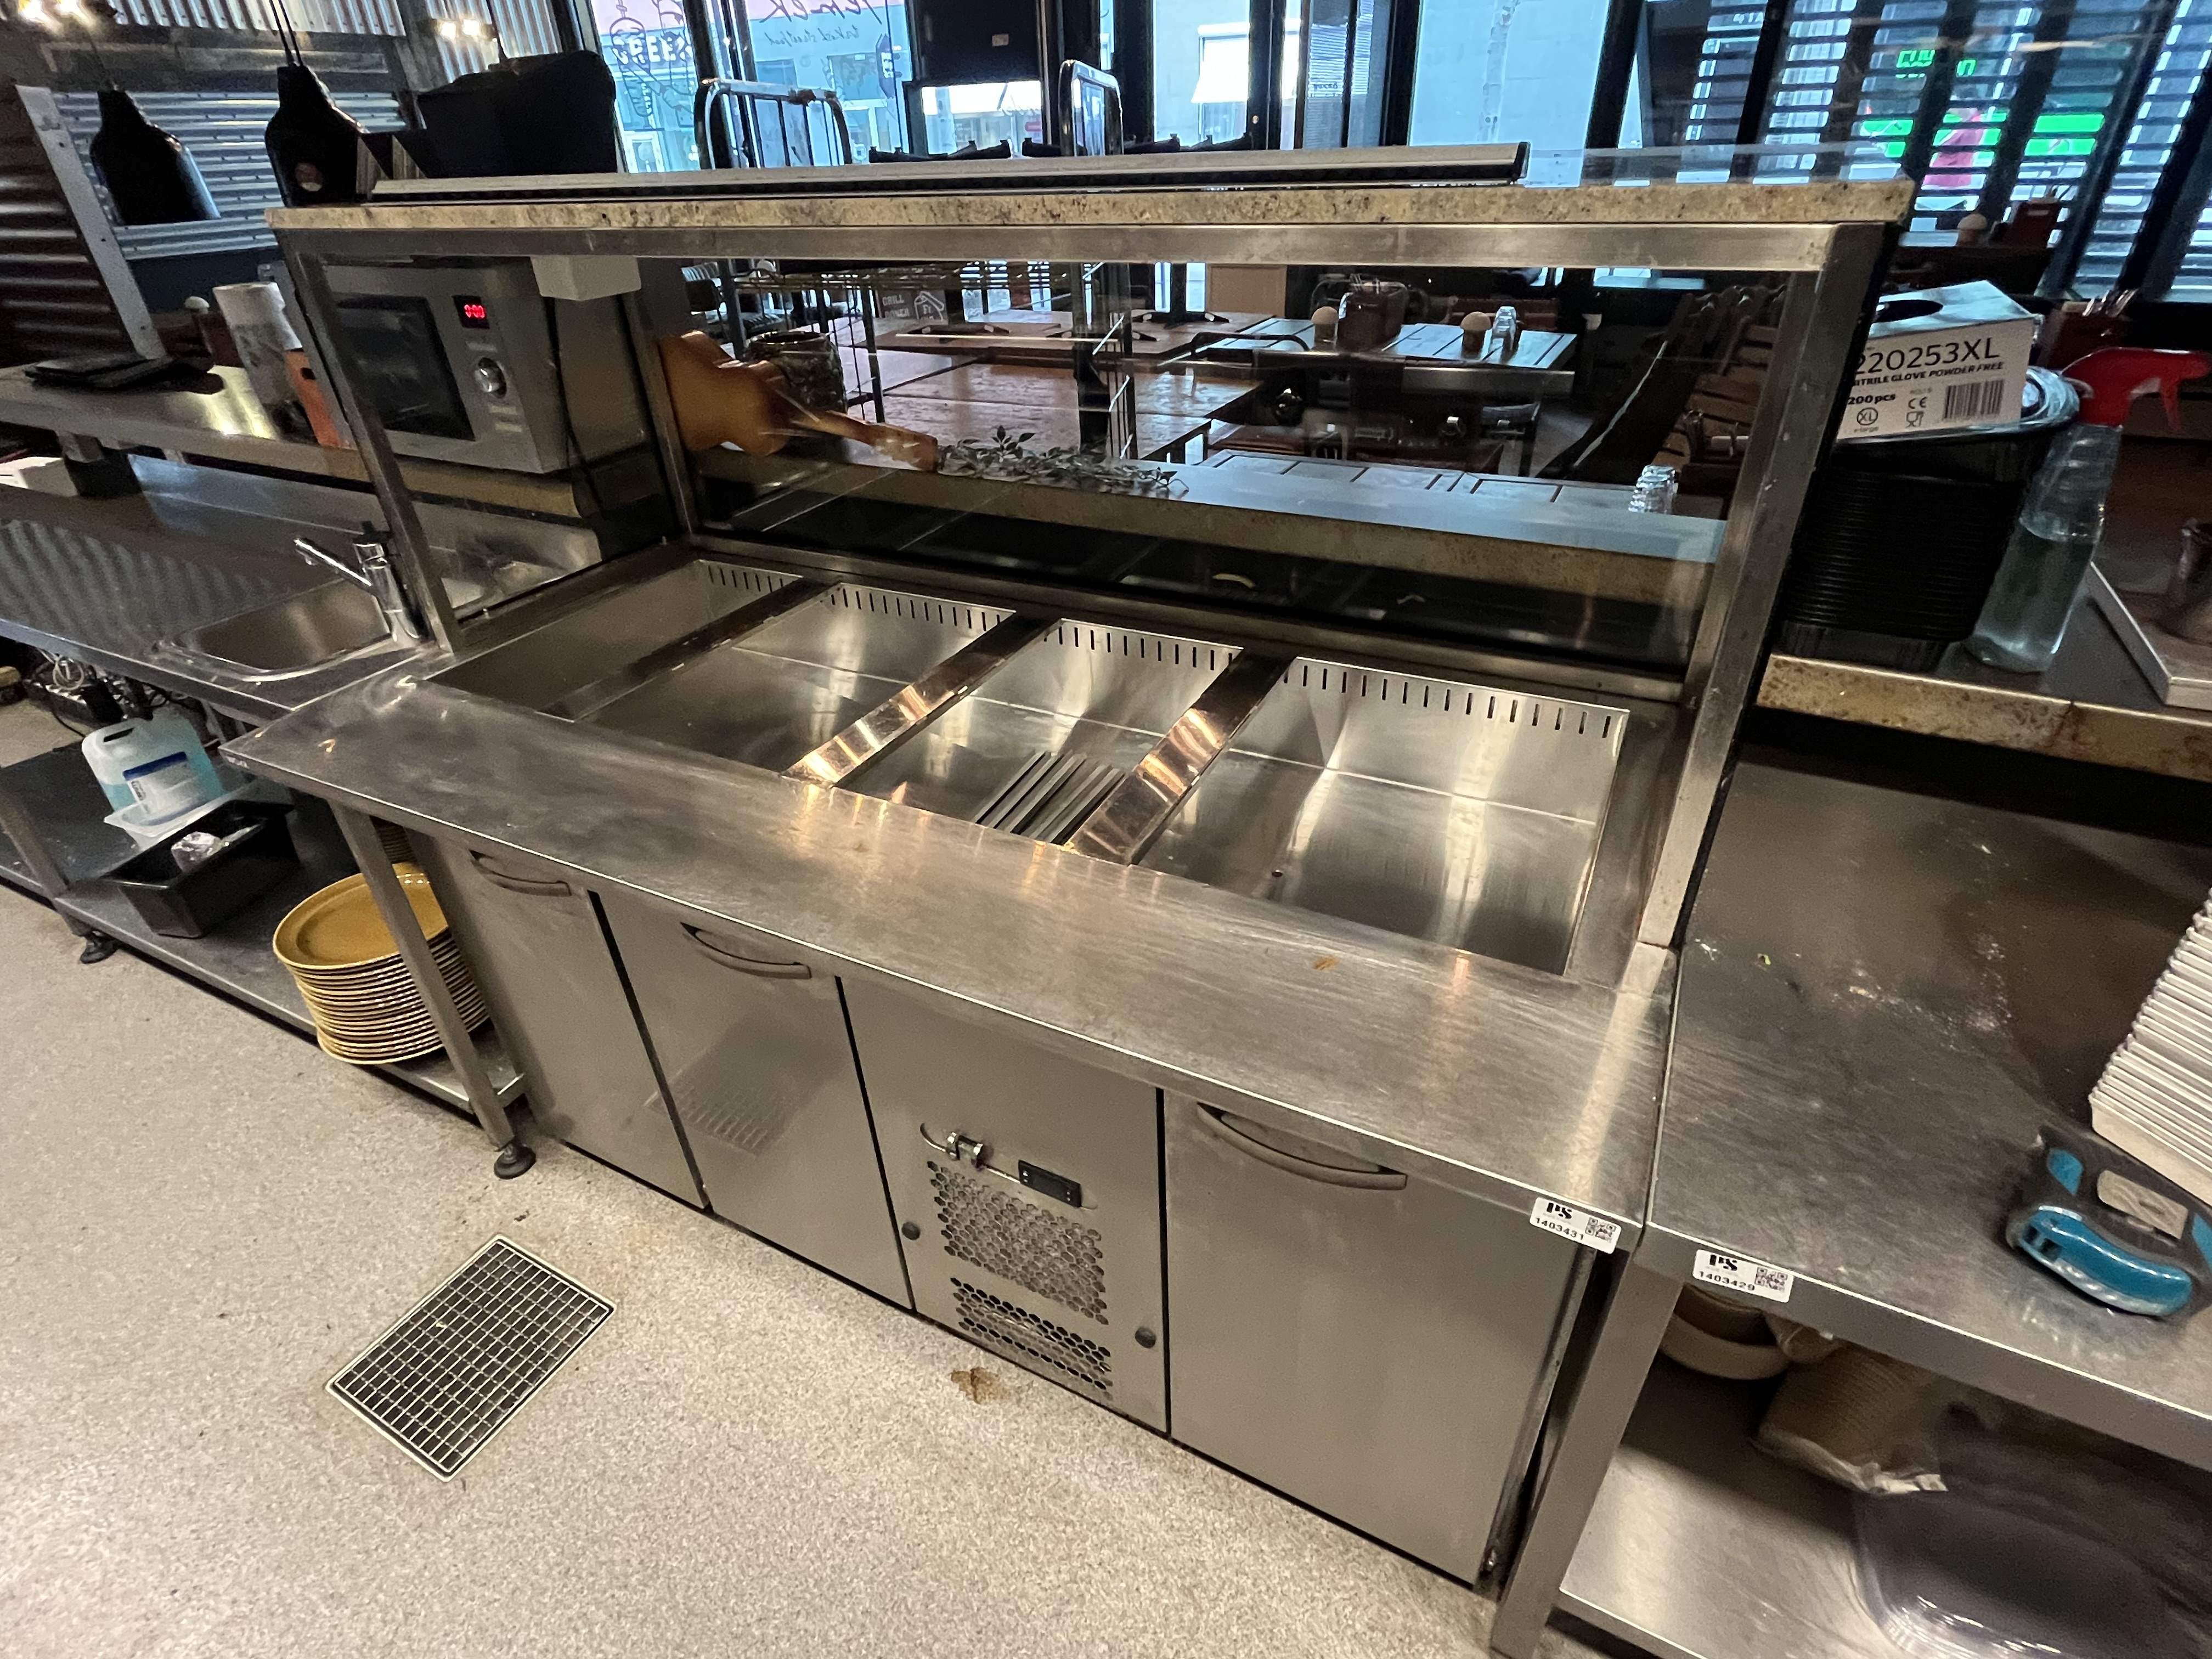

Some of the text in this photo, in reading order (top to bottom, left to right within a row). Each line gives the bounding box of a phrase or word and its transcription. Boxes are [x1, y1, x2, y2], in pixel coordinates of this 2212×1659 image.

[1855, 337, 2000, 374] 220253XL
[1891, 371, 1926, 381] GLOVE
[1929, 365, 1975, 377] POWDER
[1976, 361, 2005, 373] FREE
[1536, 1217, 1584, 1241] 1403431
[1698, 1271, 1756, 1291] 1403429
